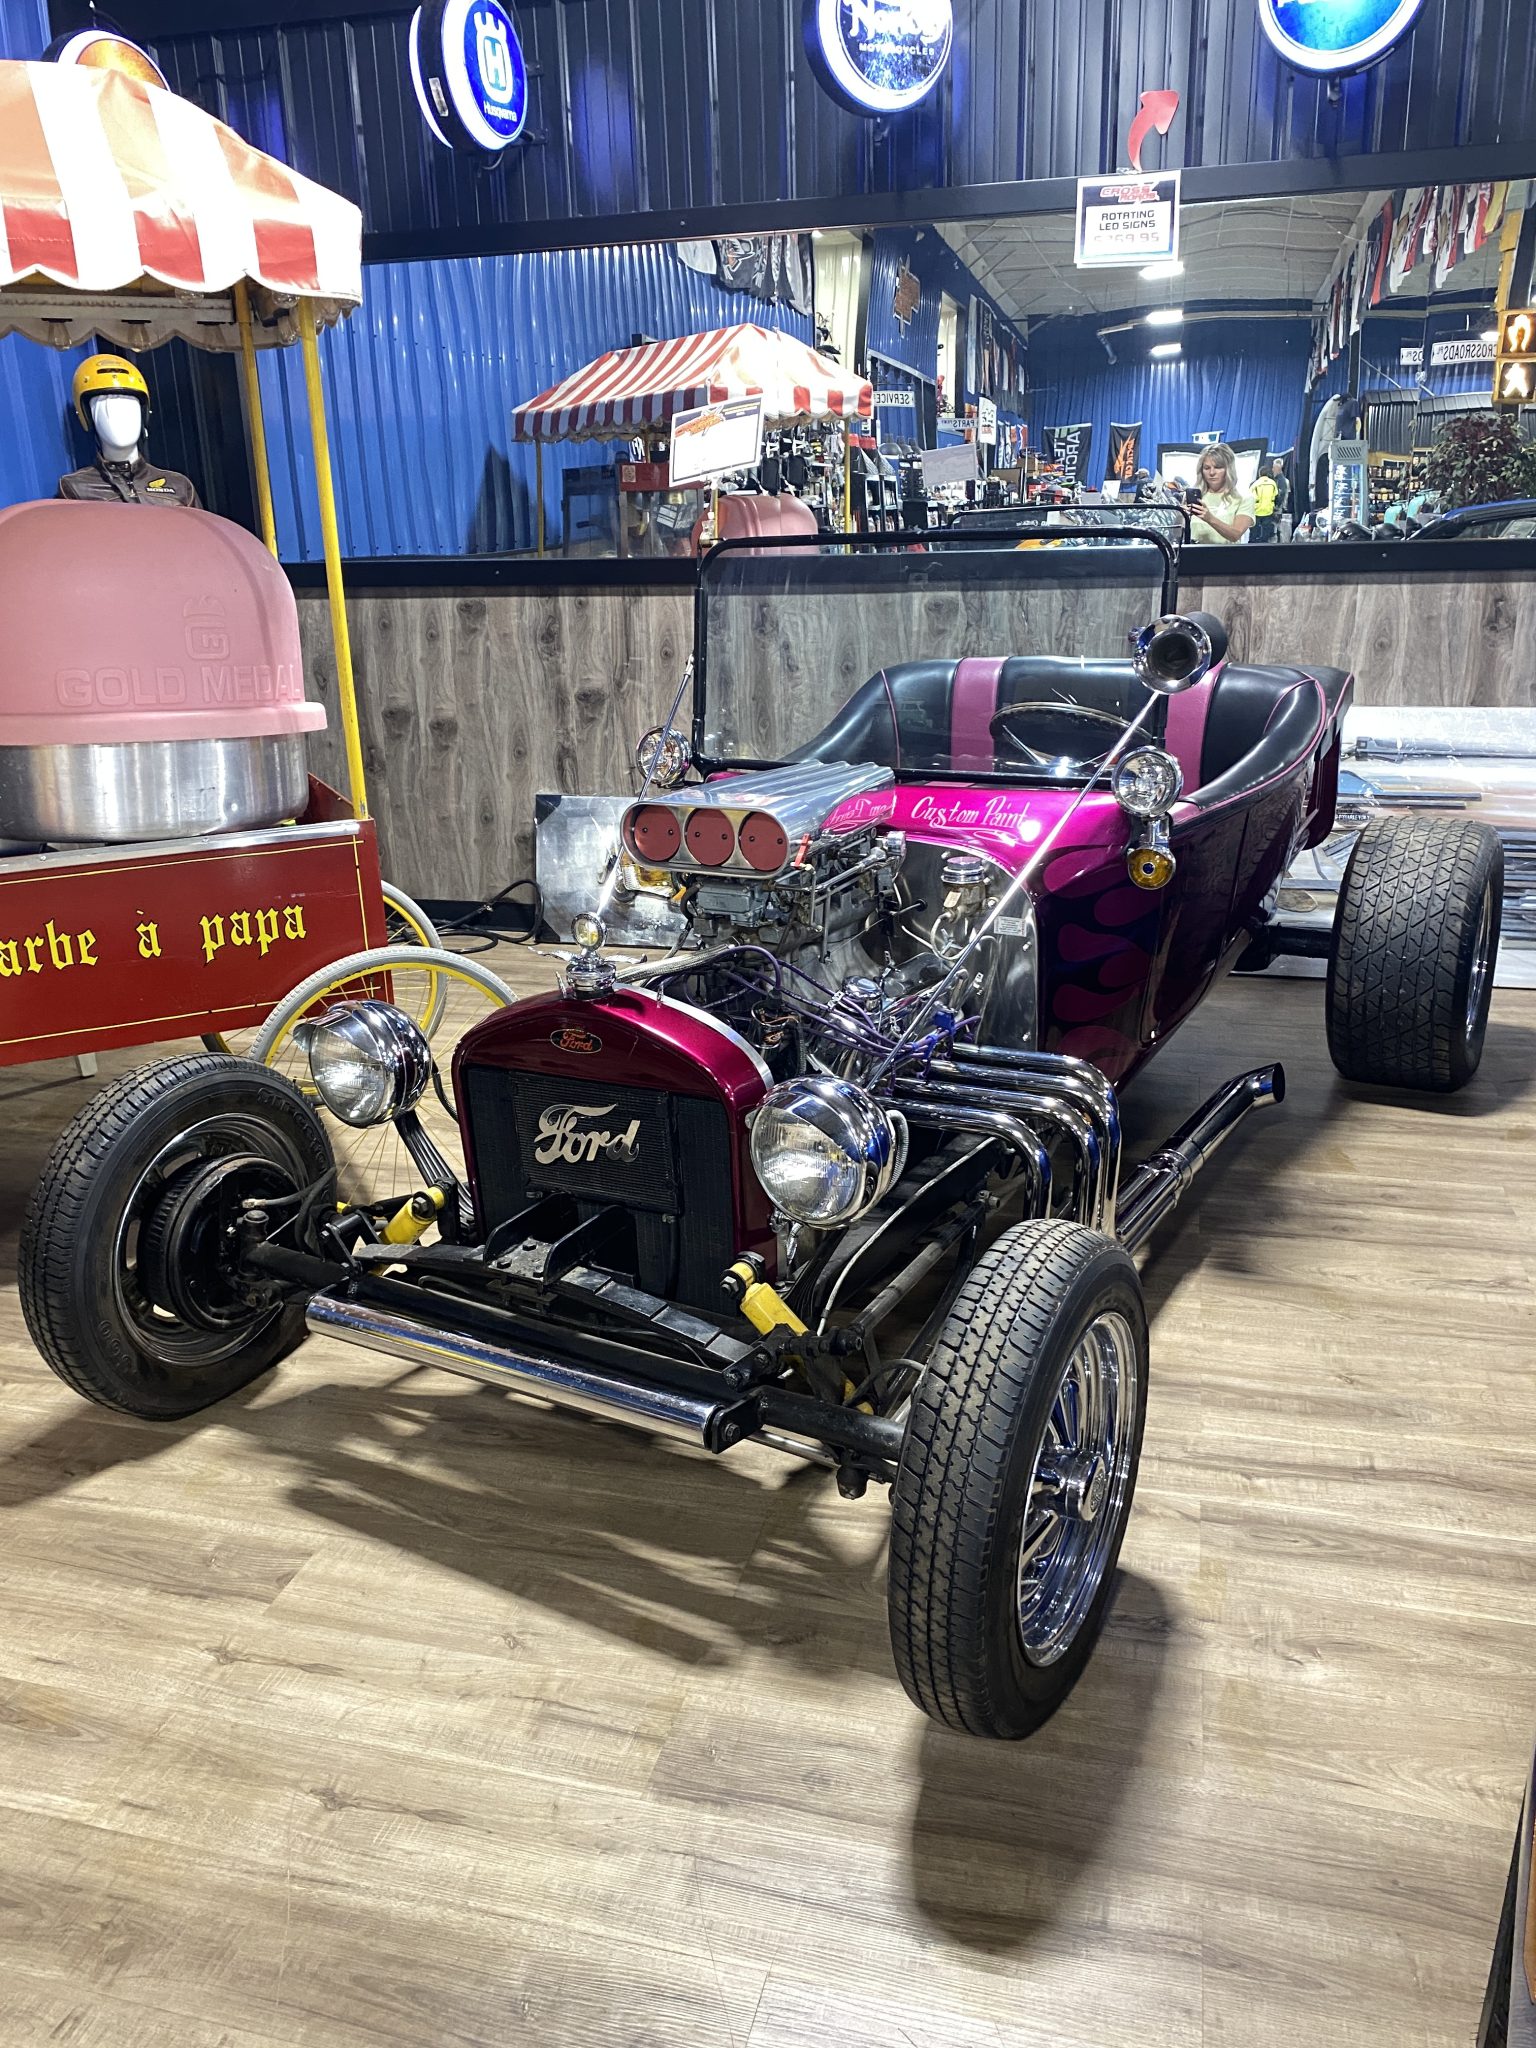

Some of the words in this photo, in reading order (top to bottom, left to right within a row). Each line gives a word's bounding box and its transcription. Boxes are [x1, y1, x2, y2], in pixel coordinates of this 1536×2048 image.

[859, 42, 935, 56] MOTORCYCLES
[1101, 186, 1151, 196] CROSS
[1102, 210, 1154, 220] ROTATING
[1122, 220, 1155, 229] SIGNS
[54, 665, 187, 707] GOLD
[200, 664, 302, 702] MEDAL
[911, 796, 980, 829] Custom
[981, 795, 1028, 829] Paint
[136, 909, 163, 959] à
[199, 903, 307, 964] papa
[560, 1031, 594, 1052] Ford
[534, 1103, 641, 1165] Ford
